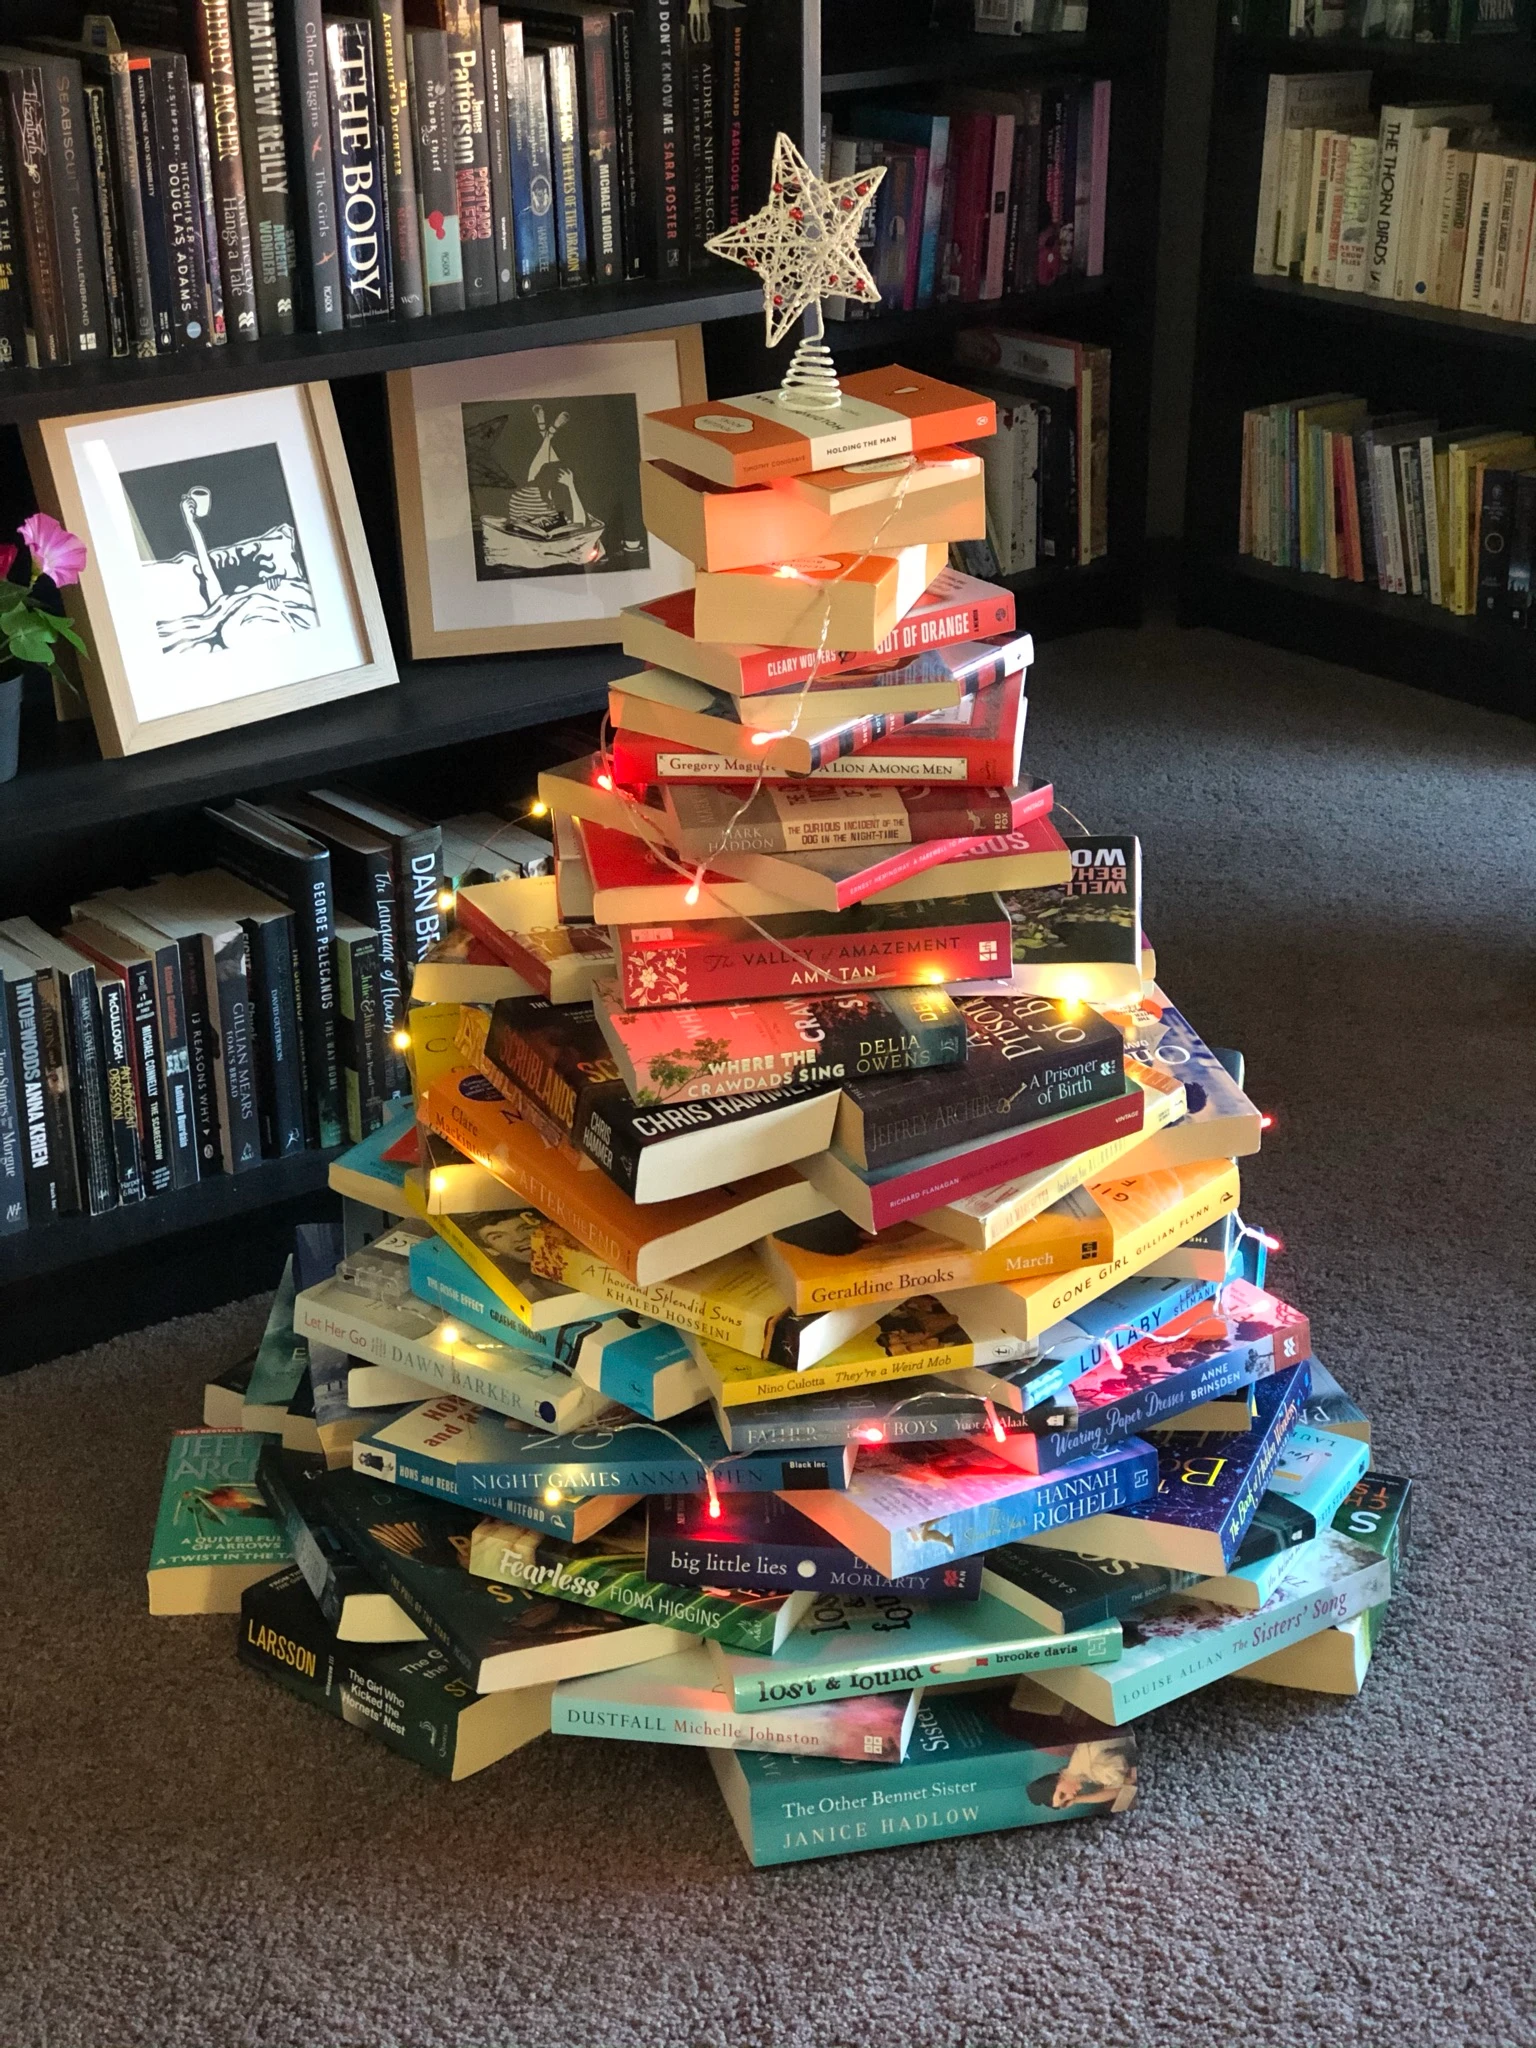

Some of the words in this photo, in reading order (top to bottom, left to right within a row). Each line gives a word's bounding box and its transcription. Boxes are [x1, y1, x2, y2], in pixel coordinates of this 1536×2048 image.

[247, 1, 282, 116] MATTHEW
[305, 22, 316, 66] Chloe
[306, 72, 321, 128] Higgins
[338, 45, 371, 155] THE
[661, 62, 673, 108] KNOW
[702, 63, 713, 130] AUDREY
[213, 82, 239, 161] ARCHER
[450, 50, 477, 164] Patterson
[472, 99, 483, 134] James
[663, 114, 674, 134] ME
[390, 105, 402, 176] DAUGHTER
[1385, 122, 1401, 152] THE
[257, 124, 288, 195] REILLY
[663, 142, 675, 181] SARA
[315, 168, 327, 197] The
[599, 163, 612, 214] MICHAEL
[1379, 157, 1397, 216] THORN
[72, 206, 82, 245] LAURA
[222, 197, 239, 247] Hangs
[317, 202, 330, 238] Girls
[342, 161, 381, 299] BODY
[665, 185, 677, 239] FOSTER
[259, 220, 276, 285] WONDERS
[273, 223, 289, 278] ANCIENT
[601, 216, 614, 255] MOORE
[1373, 220, 1390, 266] BIRDS
[75, 247, 90, 327] HILLENBRAND
[176, 251, 191, 312] ADAMS
[230, 263, 243, 297] Tale
[1473, 259, 1483, 299] IDENTITY
[826, 442, 863, 456] HOLDING
[863, 440, 880, 450] THE
[880, 435, 898, 445] MAN
[903, 626, 918, 649] OF
[921, 612, 970, 644] ORANGE
[767, 656, 798, 677] CLEARY
[670, 757, 721, 774] Gregory
[833, 762, 862, 774] LION
[868, 762, 921, 774] AMONG
[923, 764, 953, 775] MEN
[801, 833, 820, 845] DOG
[833, 832, 847, 843] THE
[803, 821, 841, 833] CURIOUS
[844, 819, 880, 831] INCIDENT
[411, 852, 440, 917] DAN
[313, 880, 328, 932] GEORGE
[376, 899, 396, 964] Language
[838, 936, 961, 960] AMAZEMENT
[316, 935, 334, 1010] PELECANOS
[790, 969, 833, 985] AMY
[838, 965, 878, 984] TAN
[141, 1025, 152, 1061] MICHAEL
[233, 1002, 248, 1065] GILLIAN
[859, 1035, 921, 1056] DELIA
[20, 1030, 41, 1081] WOODS
[708, 1053, 775, 1077] WHERE
[780, 1048, 817, 1068] THE
[856, 1050, 932, 1074] OWENS
[1029, 1073, 1042, 1090] A
[1044, 1060, 1099, 1085] Prisoner
[108, 1067, 123, 1120] OBSESSION
[145, 1062, 158, 1097] CONNELLY
[192, 1029, 207, 1090] REASONS
[200, 1093, 210, 1125] WHY
[228, 1067, 239, 1099] BREAD
[238, 1068, 253, 1120] MEARS
[687, 1073, 793, 1099] CRAWDADS
[798, 1063, 846, 1083] SING
[1037, 1088, 1054, 1107] of
[1058, 1076, 1093, 1100] Birth
[25, 1083, 44, 1122] ANNA
[631, 1104, 713, 1138] CHRIS
[29, 1122, 49, 1168] KRIEN
[152, 1117, 164, 1160] SCARECROW
[590, 1110, 612, 1145] CHRIS
[583, 1126, 614, 1171] HAMMER
[519, 1169, 567, 1223] AFTER
[889, 1188, 921, 1208] RICHARD
[922, 1177, 960, 1198] FLANAGAN
[1005, 1253, 1055, 1272] March
[1052, 1278, 1093, 1310] GONE
[1098, 1255, 1130, 1281] GIRL
[1135, 1227, 1176, 1257] GILLIAN
[1179, 1204, 1211, 1230] FLYNN
[597, 1265, 649, 1297] Thousand
[651, 1287, 706, 1318] Splendid
[709, 1306, 743, 1328] Suns
[810, 1277, 894, 1304] Geraldine
[899, 1268, 955, 1290] Brooks
[606, 1287, 661, 1316] KHALED
[665, 1309, 731, 1343] HOSSEINI
[304, 1312, 321, 1332] Let
[323, 1316, 346, 1338] Her
[349, 1329, 367, 1348] Go
[392, 1345, 445, 1379] DAWN
[451, 1370, 522, 1410] BARKER
[757, 1380, 784, 1396] Nino
[786, 1376, 826, 1391] Culotta
[835, 1367, 881, 1384] They're
[891, 1359, 924, 1374] Weird
[926, 1355, 952, 1369] Mob
[1200, 1362, 1229, 1383] ANNE
[1190, 1371, 1241, 1401] BRINSDEN
[894, 1419, 938, 1436] BOYS
[1051, 1429, 1105, 1458] Wearing
[1106, 1406, 1144, 1435] Paper
[1145, 1390, 1187, 1418] Dresses
[399, 1465, 419, 1482] HONS
[421, 1474, 434, 1487] and
[471, 1474, 543, 1491] NIGHT
[547, 1471, 622, 1488] GAMES
[1036, 1467, 1118, 1508] HANNAH
[505, 1499, 546, 1523] MITFORD
[1033, 1487, 1127, 1532] RICHELL
[169, 1554, 220, 1564] TWIST
[240, 1553, 277, 1561] THE
[195, 1535, 255, 1546] QUIVER
[218, 1542, 281, 1550] ARROWS
[500, 1548, 600, 1599] Fearless
[609, 1585, 655, 1613] FIONA
[658, 1598, 722, 1630] HIGGINS
[670, 1551, 701, 1576] big
[705, 1552, 751, 1574] little
[756, 1557, 787, 1576] lies
[830, 1571, 930, 1591] MORIARTY
[247, 1618, 318, 1679] LARSSON
[1122, 1674, 1173, 1705] LOUISE
[1180, 1651, 1224, 1681] ALLAN
[1232, 1637, 1250, 1654] The
[1251, 1606, 1310, 1648] Sisters'
[1313, 1592, 1347, 1622] Song
[348, 1668, 366, 1686] The
[366, 1678, 384, 1697] Girl
[383, 1688, 406, 1710] Who
[757, 1677, 818, 1703] lost
[995, 1651, 1041, 1665] brooke
[1043, 1644, 1078, 1659] davis
[350, 1682, 384, 1708] Kicked
[384, 1702, 401, 1719] the
[382, 1714, 407, 1738] Nest
[567, 1708, 667, 1732] DUSTFALL
[673, 1719, 742, 1739] Michelle
[749, 1725, 820, 1747] Johnston
[781, 1801, 815, 1820] The
[819, 1793, 867, 1815] Other
[871, 1785, 927, 1807] Bennet
[931, 1778, 978, 1798] Sister
[781, 1815, 868, 1850] JANICE
[880, 1805, 981, 1836] HADLOW
